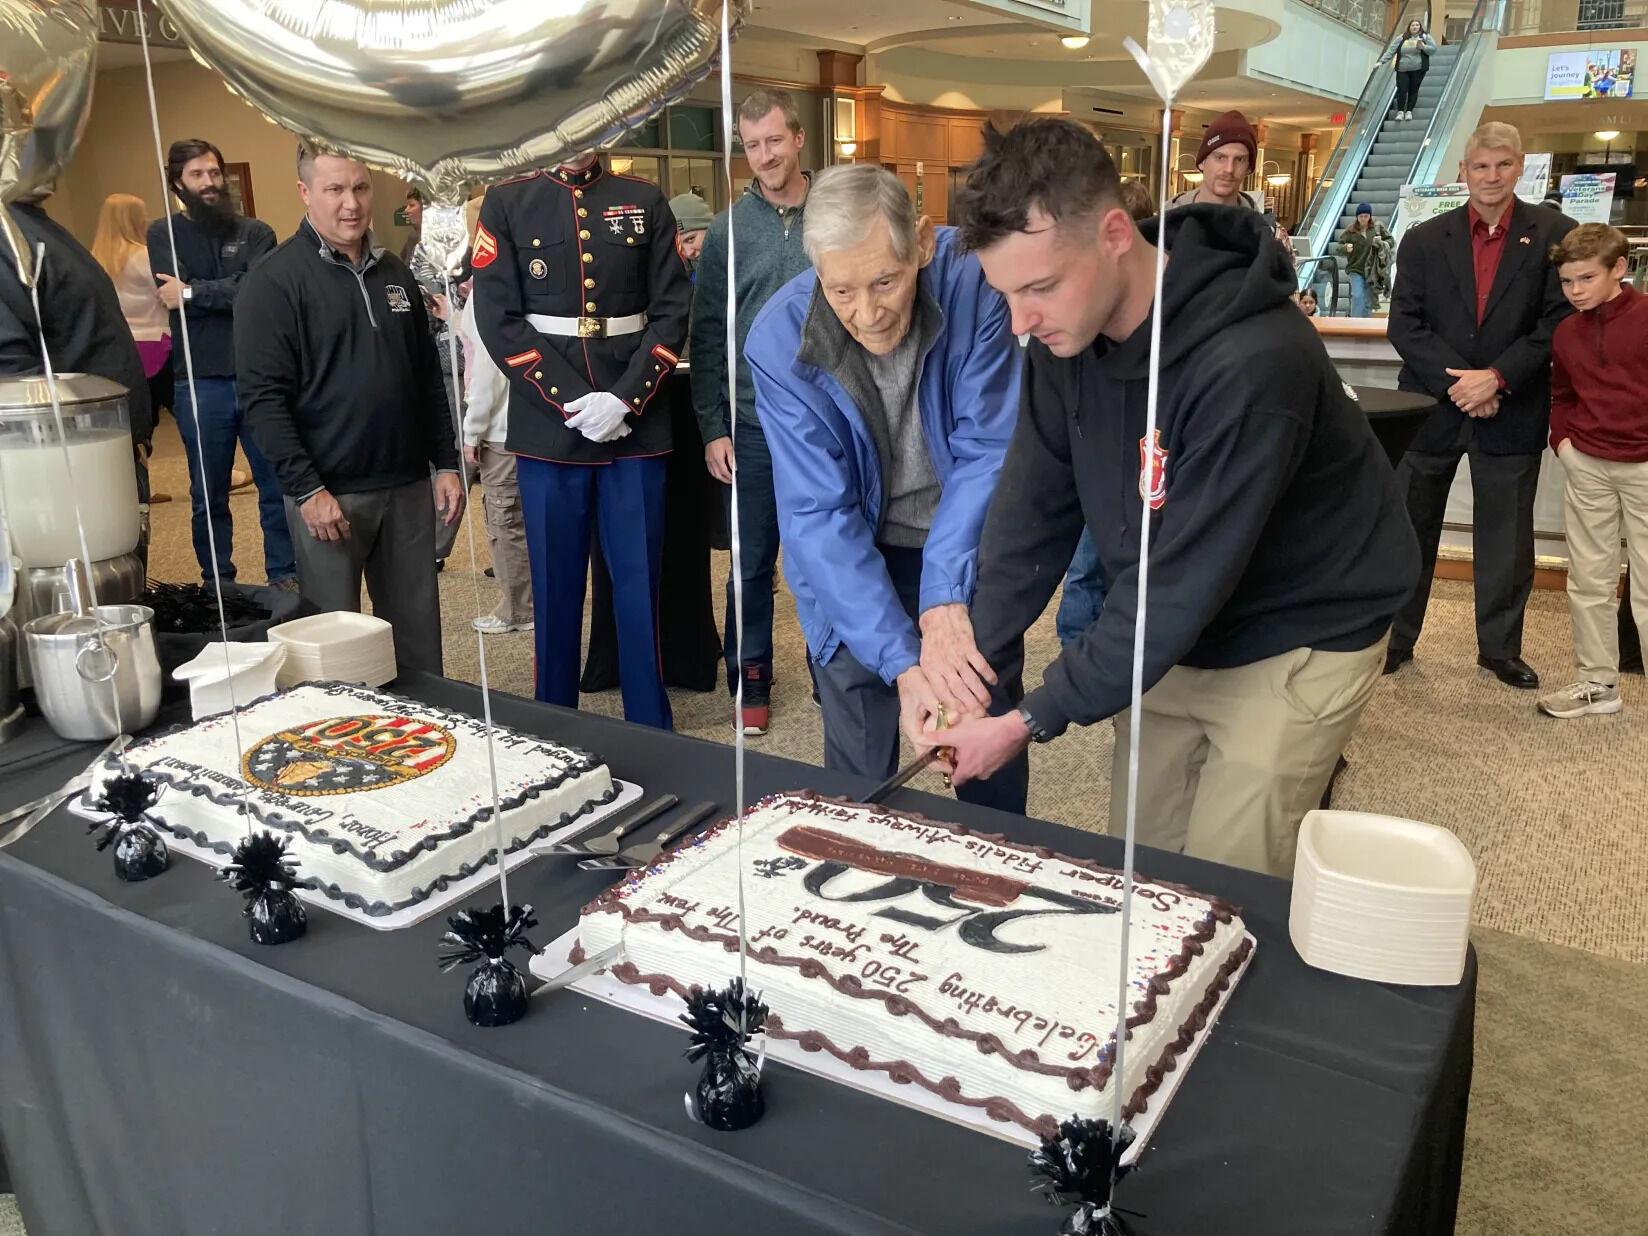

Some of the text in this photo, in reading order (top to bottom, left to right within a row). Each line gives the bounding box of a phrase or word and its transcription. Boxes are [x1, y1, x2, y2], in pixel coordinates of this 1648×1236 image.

[1551, 72, 1580, 80] journey
[706, 906, 740, 933] The
[751, 926, 789, 943] of
[879, 933, 920, 964] The
[799, 935, 871, 963] years
[860, 960, 928, 993] 250
[939, 972, 1097, 1061] Celebrating
